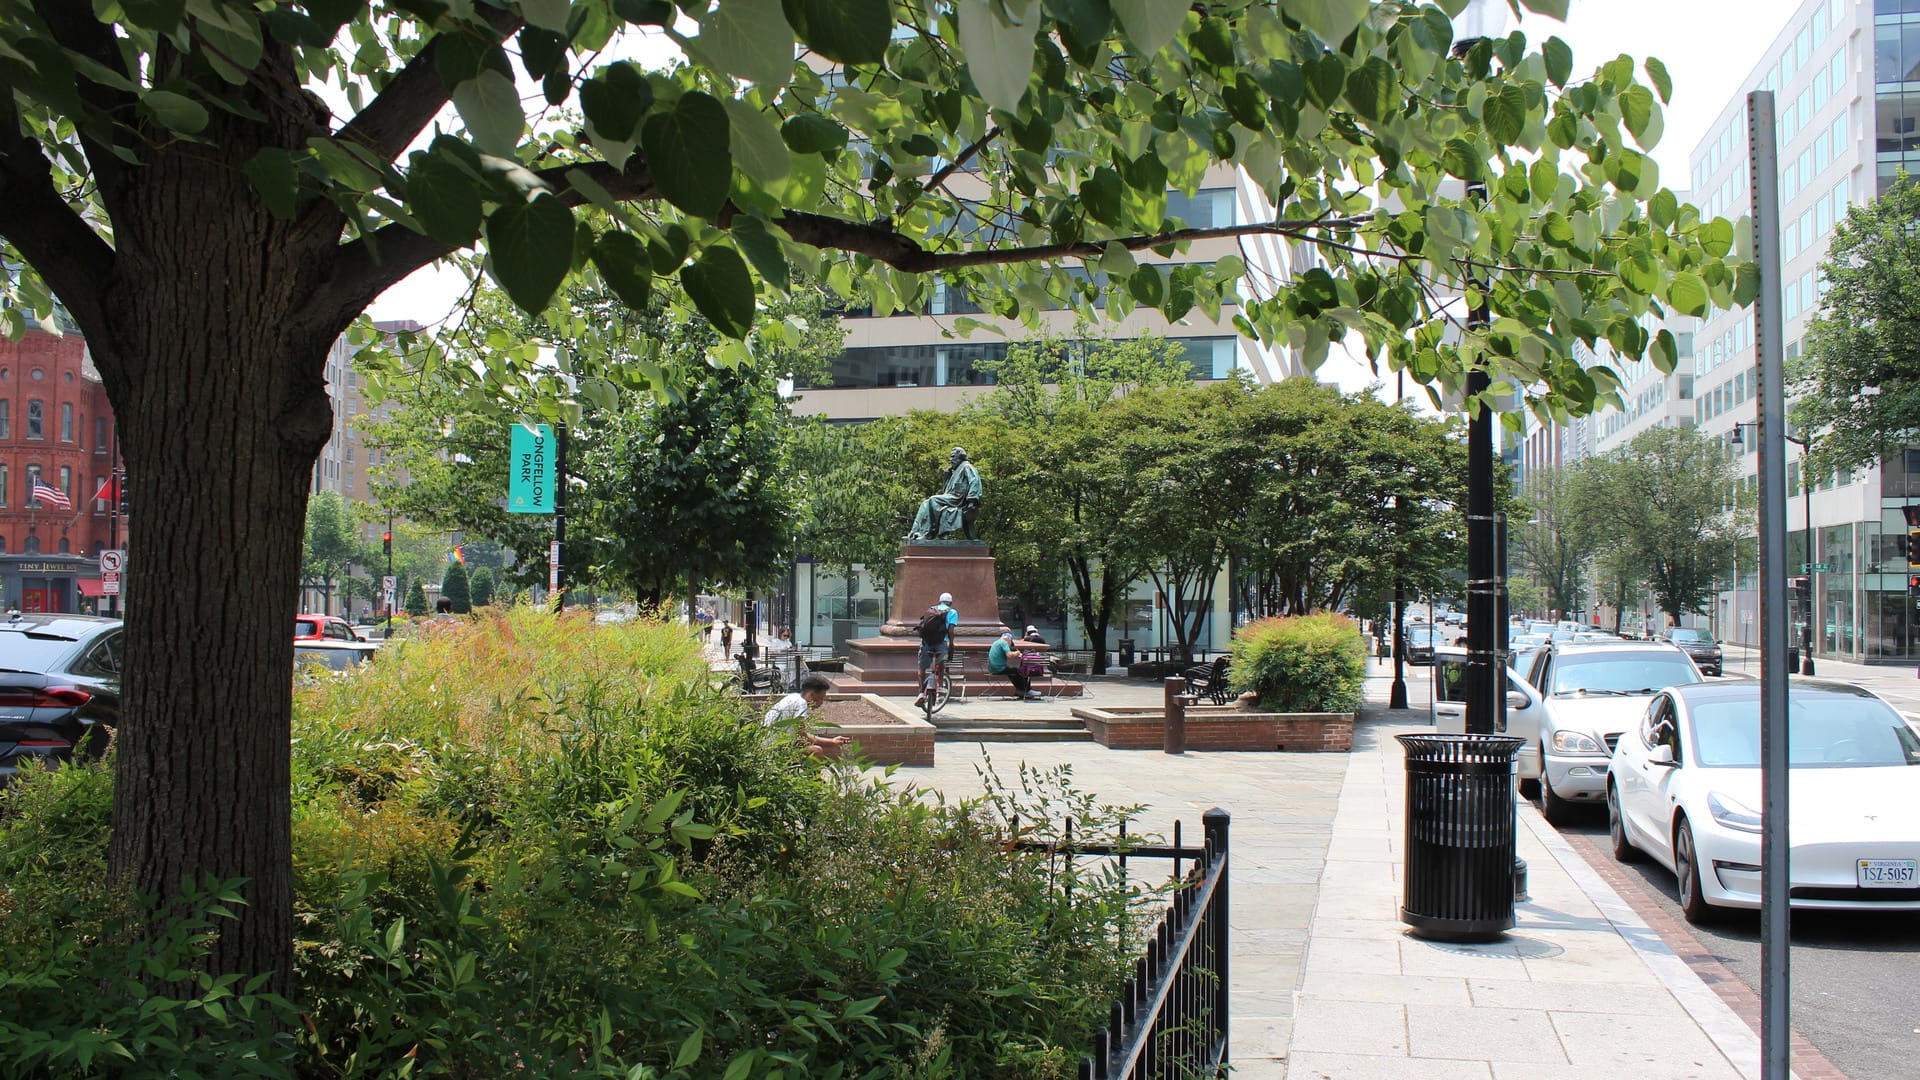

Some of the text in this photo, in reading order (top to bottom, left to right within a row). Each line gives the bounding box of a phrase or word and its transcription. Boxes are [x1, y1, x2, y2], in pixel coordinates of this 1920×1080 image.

[521, 453, 532, 483] PARK
[533, 430, 545, 507] ONGFELLOW
[1862, 867, 1914, 881] TSZ-5057
